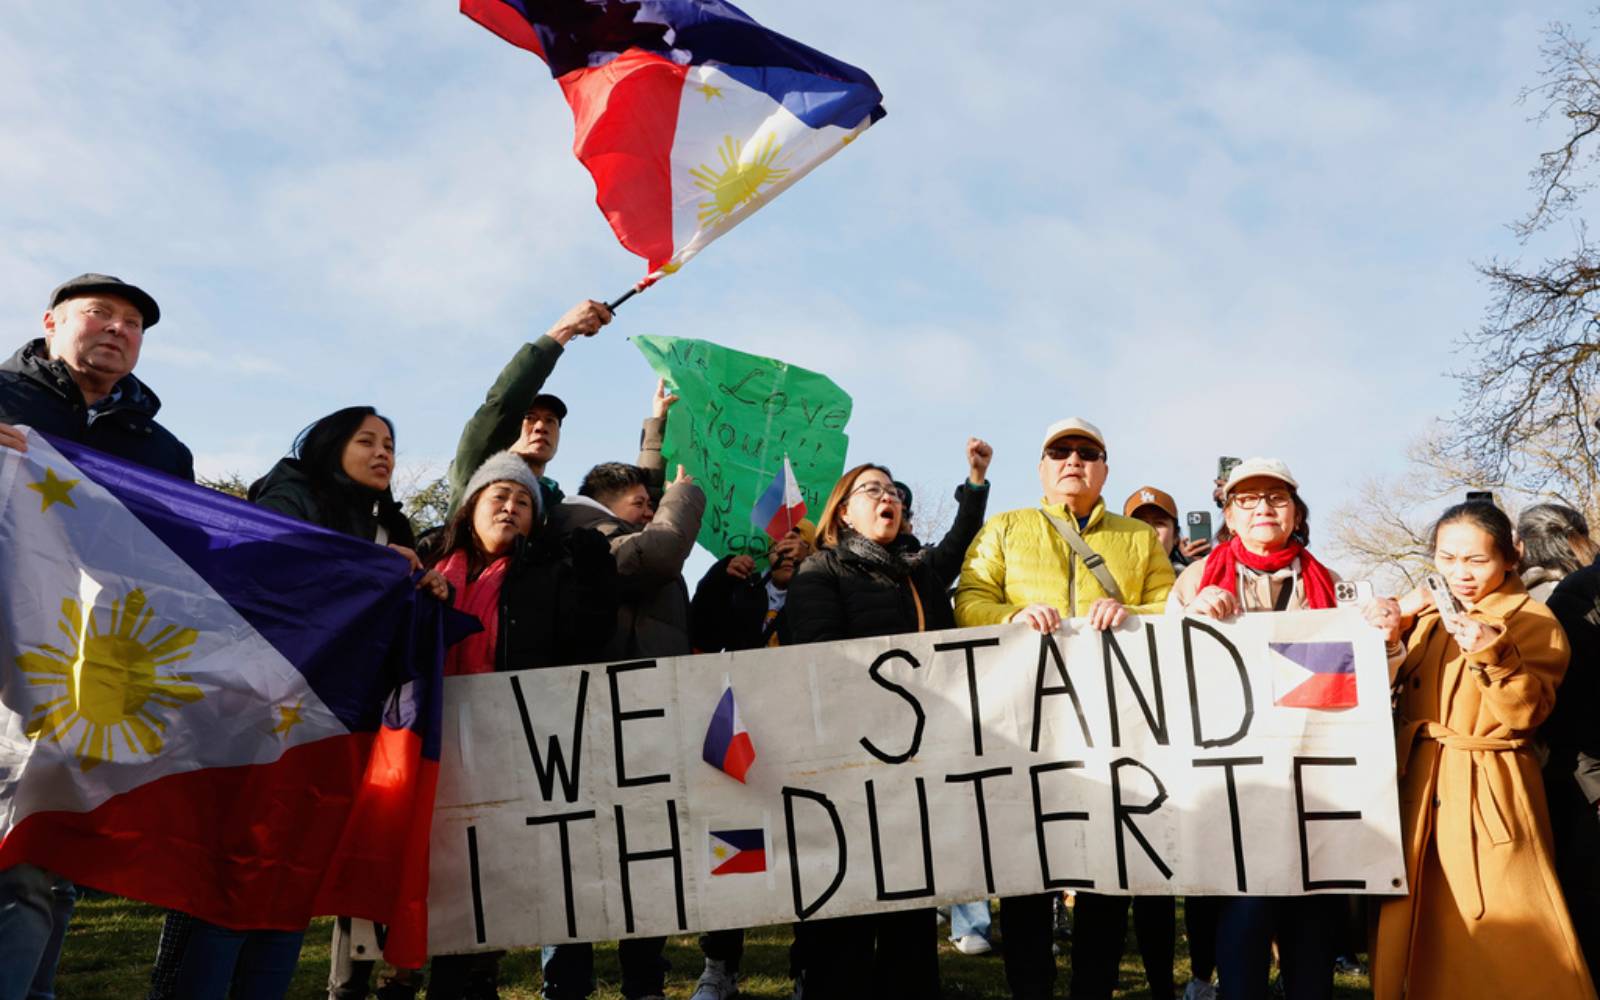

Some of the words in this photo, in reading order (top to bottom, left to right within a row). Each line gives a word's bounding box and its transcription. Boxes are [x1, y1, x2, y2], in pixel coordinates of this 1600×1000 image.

[718, 368, 847, 429] Love
[510, 660, 671, 803] WE
[859, 617, 1255, 765] STAND
[467, 800, 688, 944] ITH
[781, 756, 1367, 921] DUTERTE
